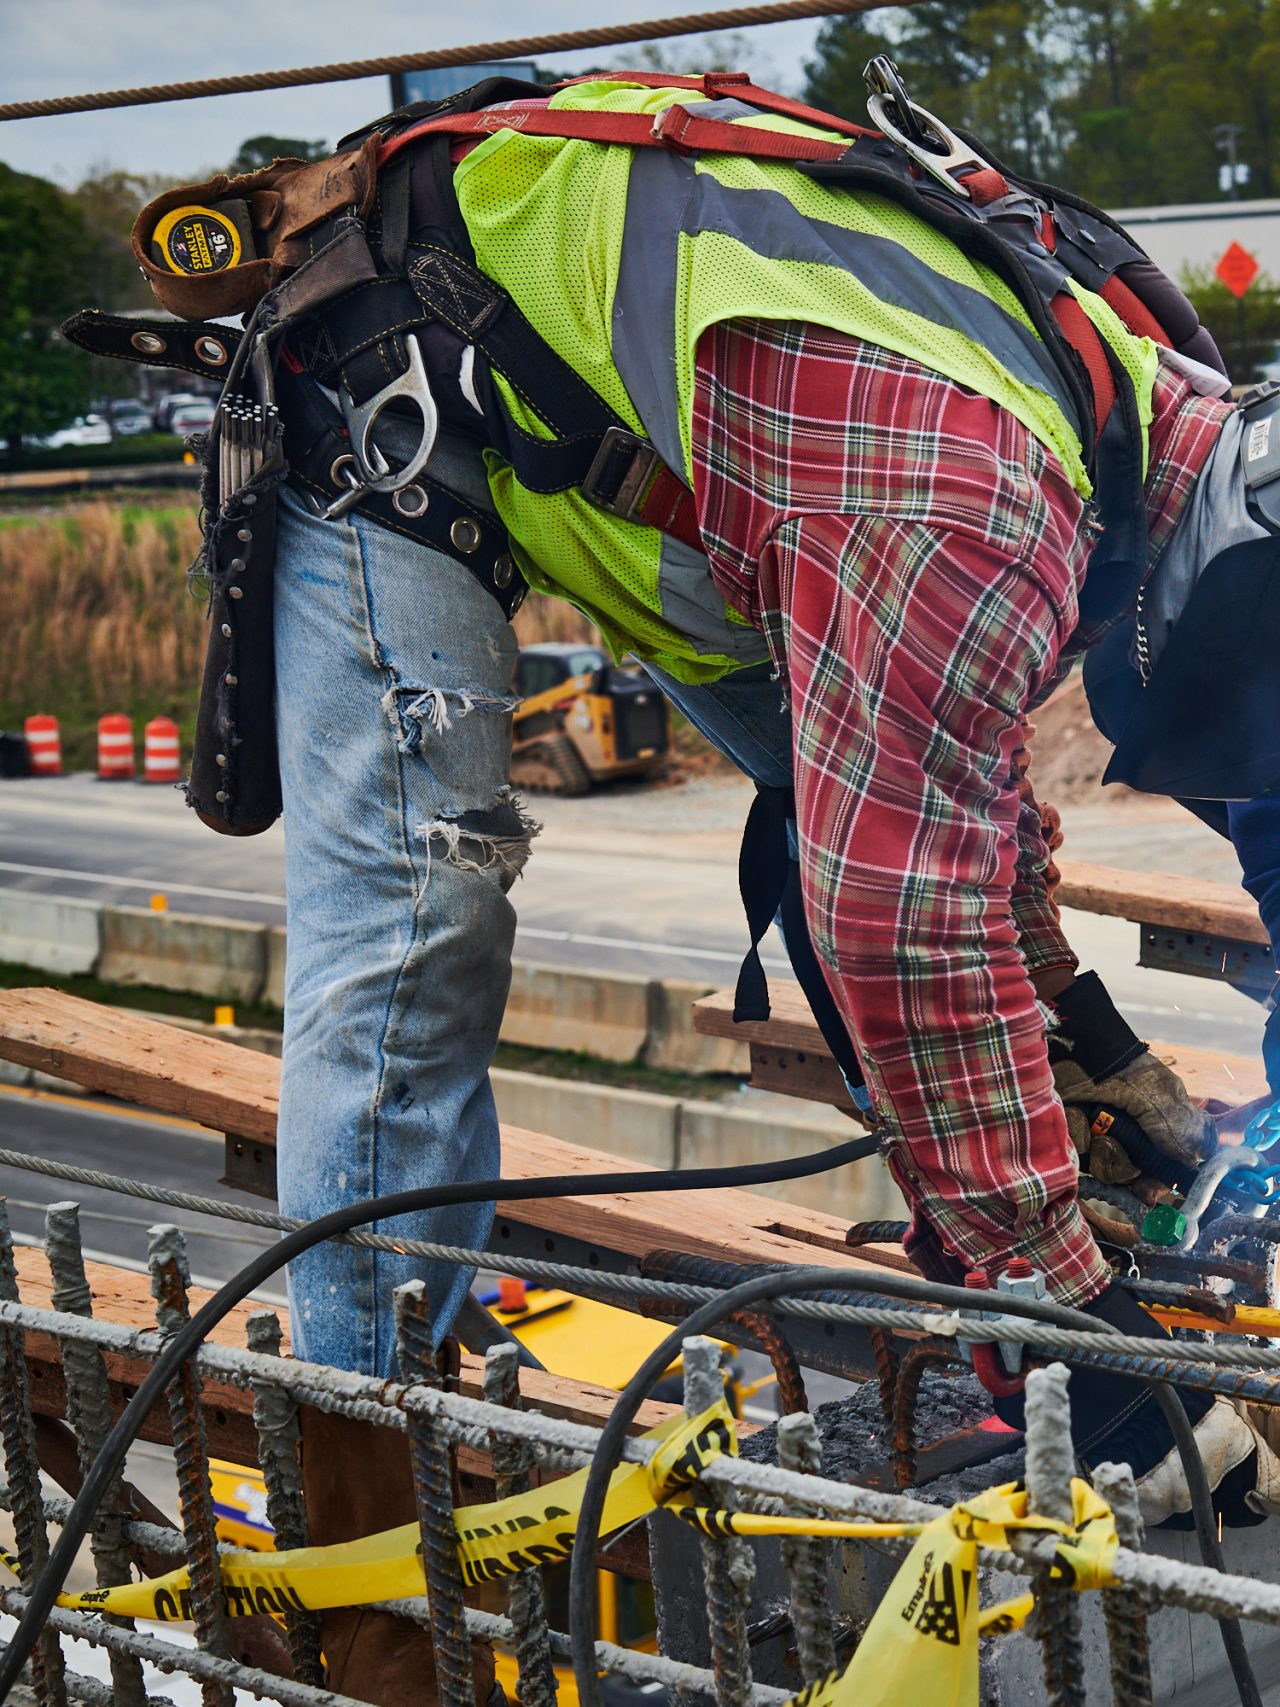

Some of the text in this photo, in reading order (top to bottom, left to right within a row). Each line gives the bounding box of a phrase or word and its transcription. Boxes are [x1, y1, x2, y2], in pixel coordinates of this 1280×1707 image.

[184, 226, 203, 270] STANLEY
[195, 226, 211, 266] FATMAX
[902, 1551, 934, 1622] Empire
